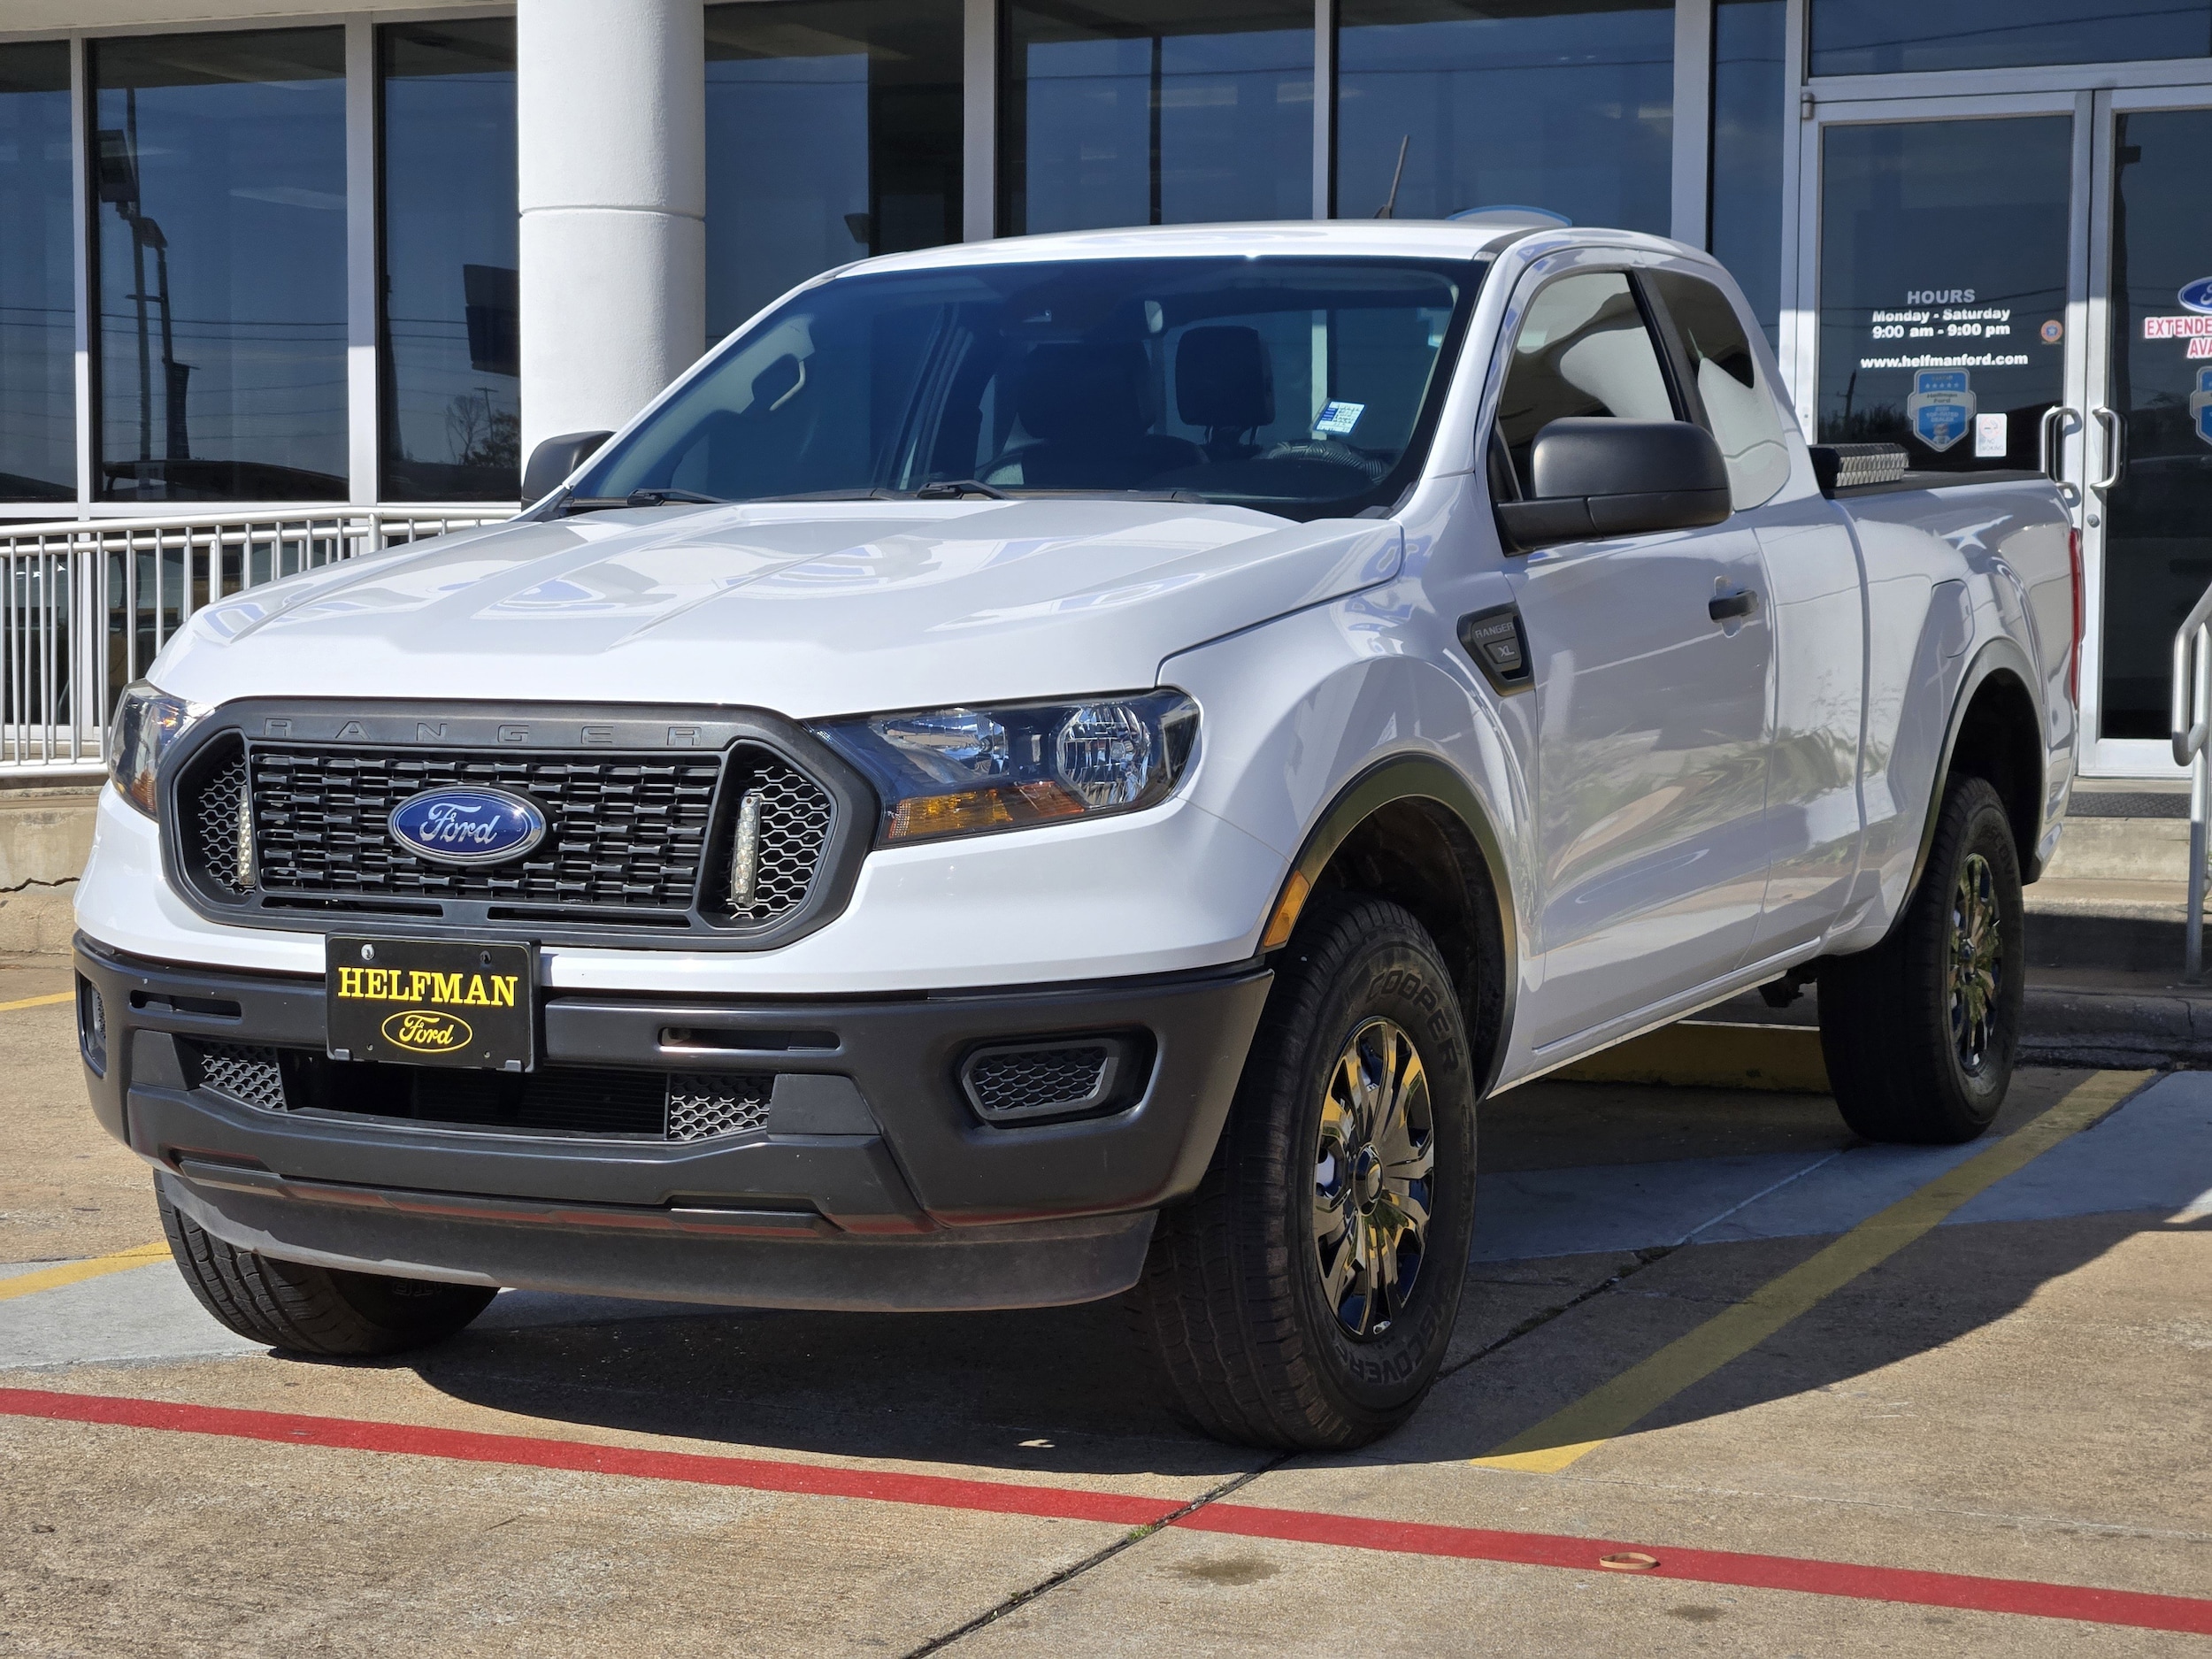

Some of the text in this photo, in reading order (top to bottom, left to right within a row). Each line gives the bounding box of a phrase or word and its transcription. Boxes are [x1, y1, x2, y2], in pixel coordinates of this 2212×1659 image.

[1907, 289, 1975, 304] HOURS
[1871, 311, 1930, 324] Monday
[1942, 308, 2010, 321] Saturday
[1872, 325, 1904, 339] 9:00
[1909, 326, 1934, 338] am
[1947, 324, 1982, 337] 9:00
[1985, 325, 2010, 338] pm
[1860, 353, 2029, 369] www.helfmanford.com
[1475, 622, 1514, 638] RANGER
[1498, 645, 1515, 657] XL
[265, 718, 703, 747] RANGER
[419, 803, 501, 844] Ford
[337, 967, 518, 1007] HELFMAN
[1366, 970, 1459, 1072] COOPER
[399, 1015, 454, 1045] Ford
